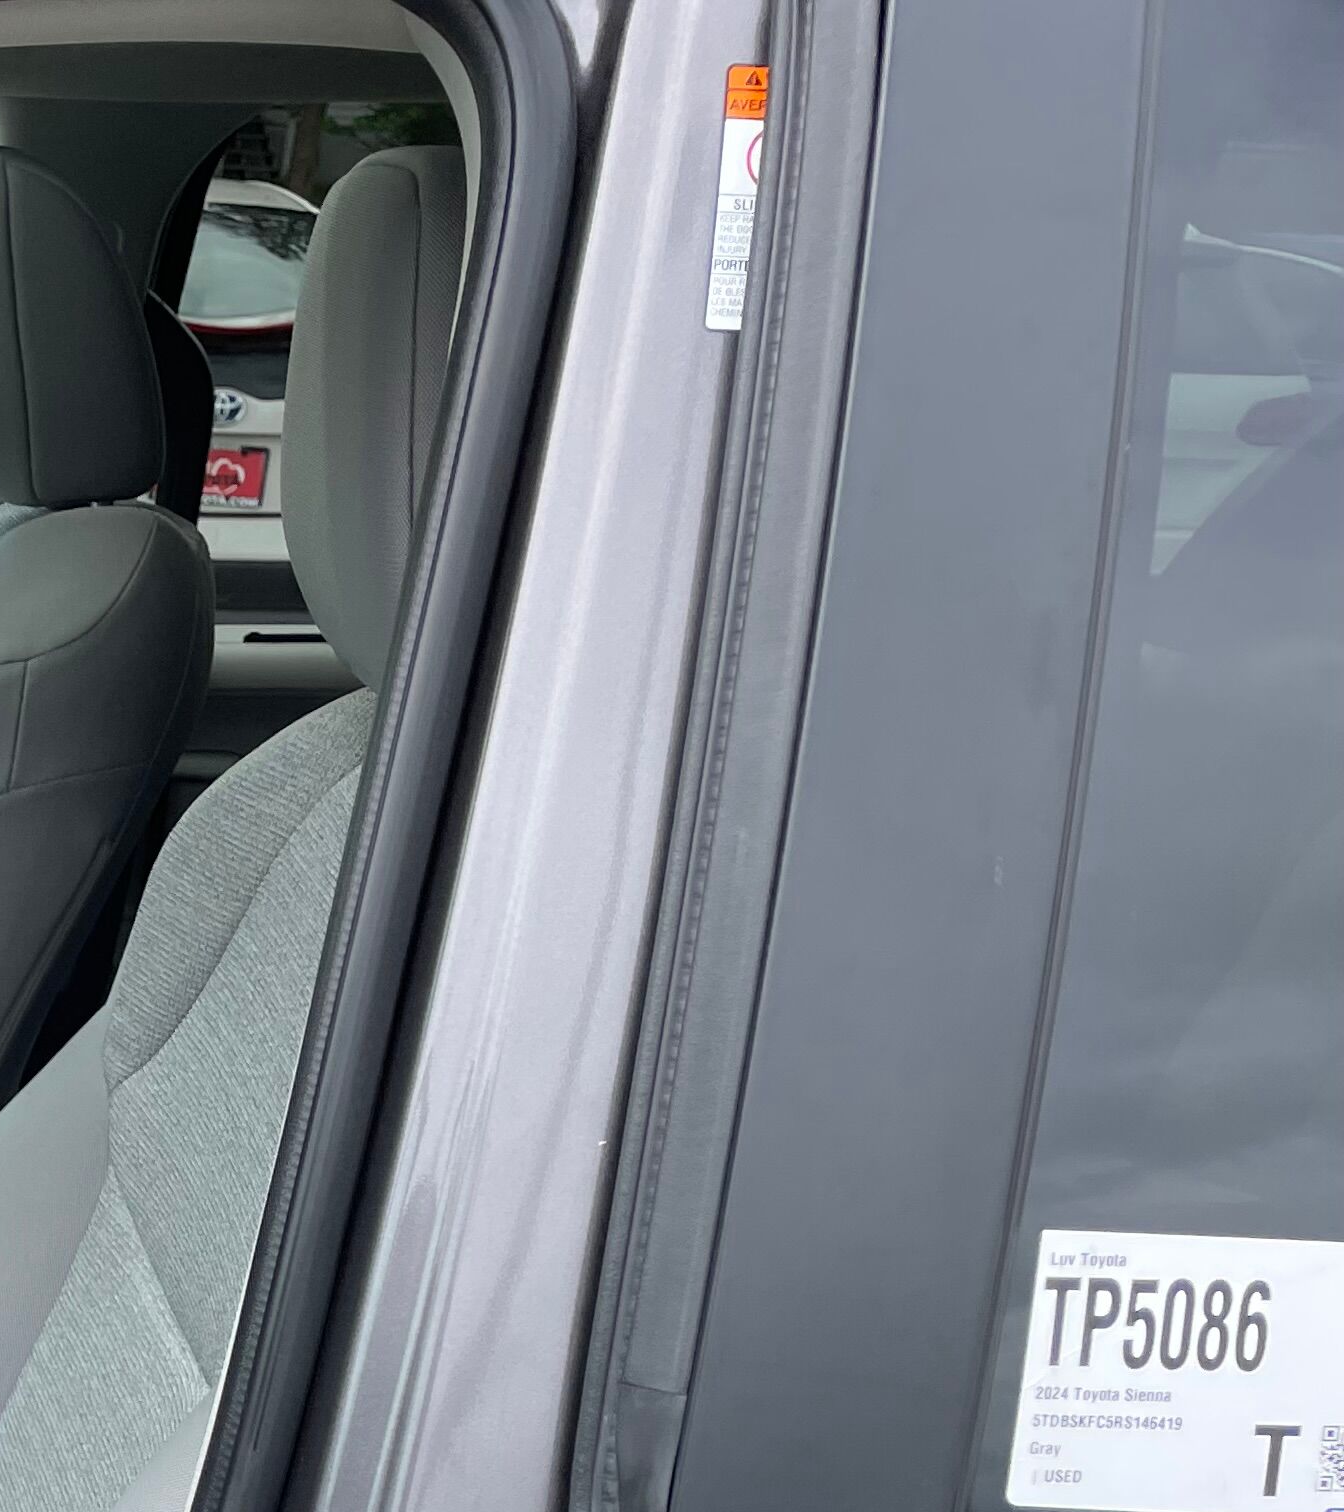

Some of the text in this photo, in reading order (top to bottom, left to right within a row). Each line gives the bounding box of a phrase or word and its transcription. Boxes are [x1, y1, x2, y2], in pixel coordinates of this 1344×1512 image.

[1050, 1252, 1127, 1269] Luv Toyota
[1045, 1276, 1272, 1372] TP5086
[1035, 1386, 1172, 1403] 2024 Toyota Sienna
[1029, 1441, 1062, 1457] Gray
[1254, 1424, 1302, 1497] T
[1044, 1470, 1083, 1484] USED
